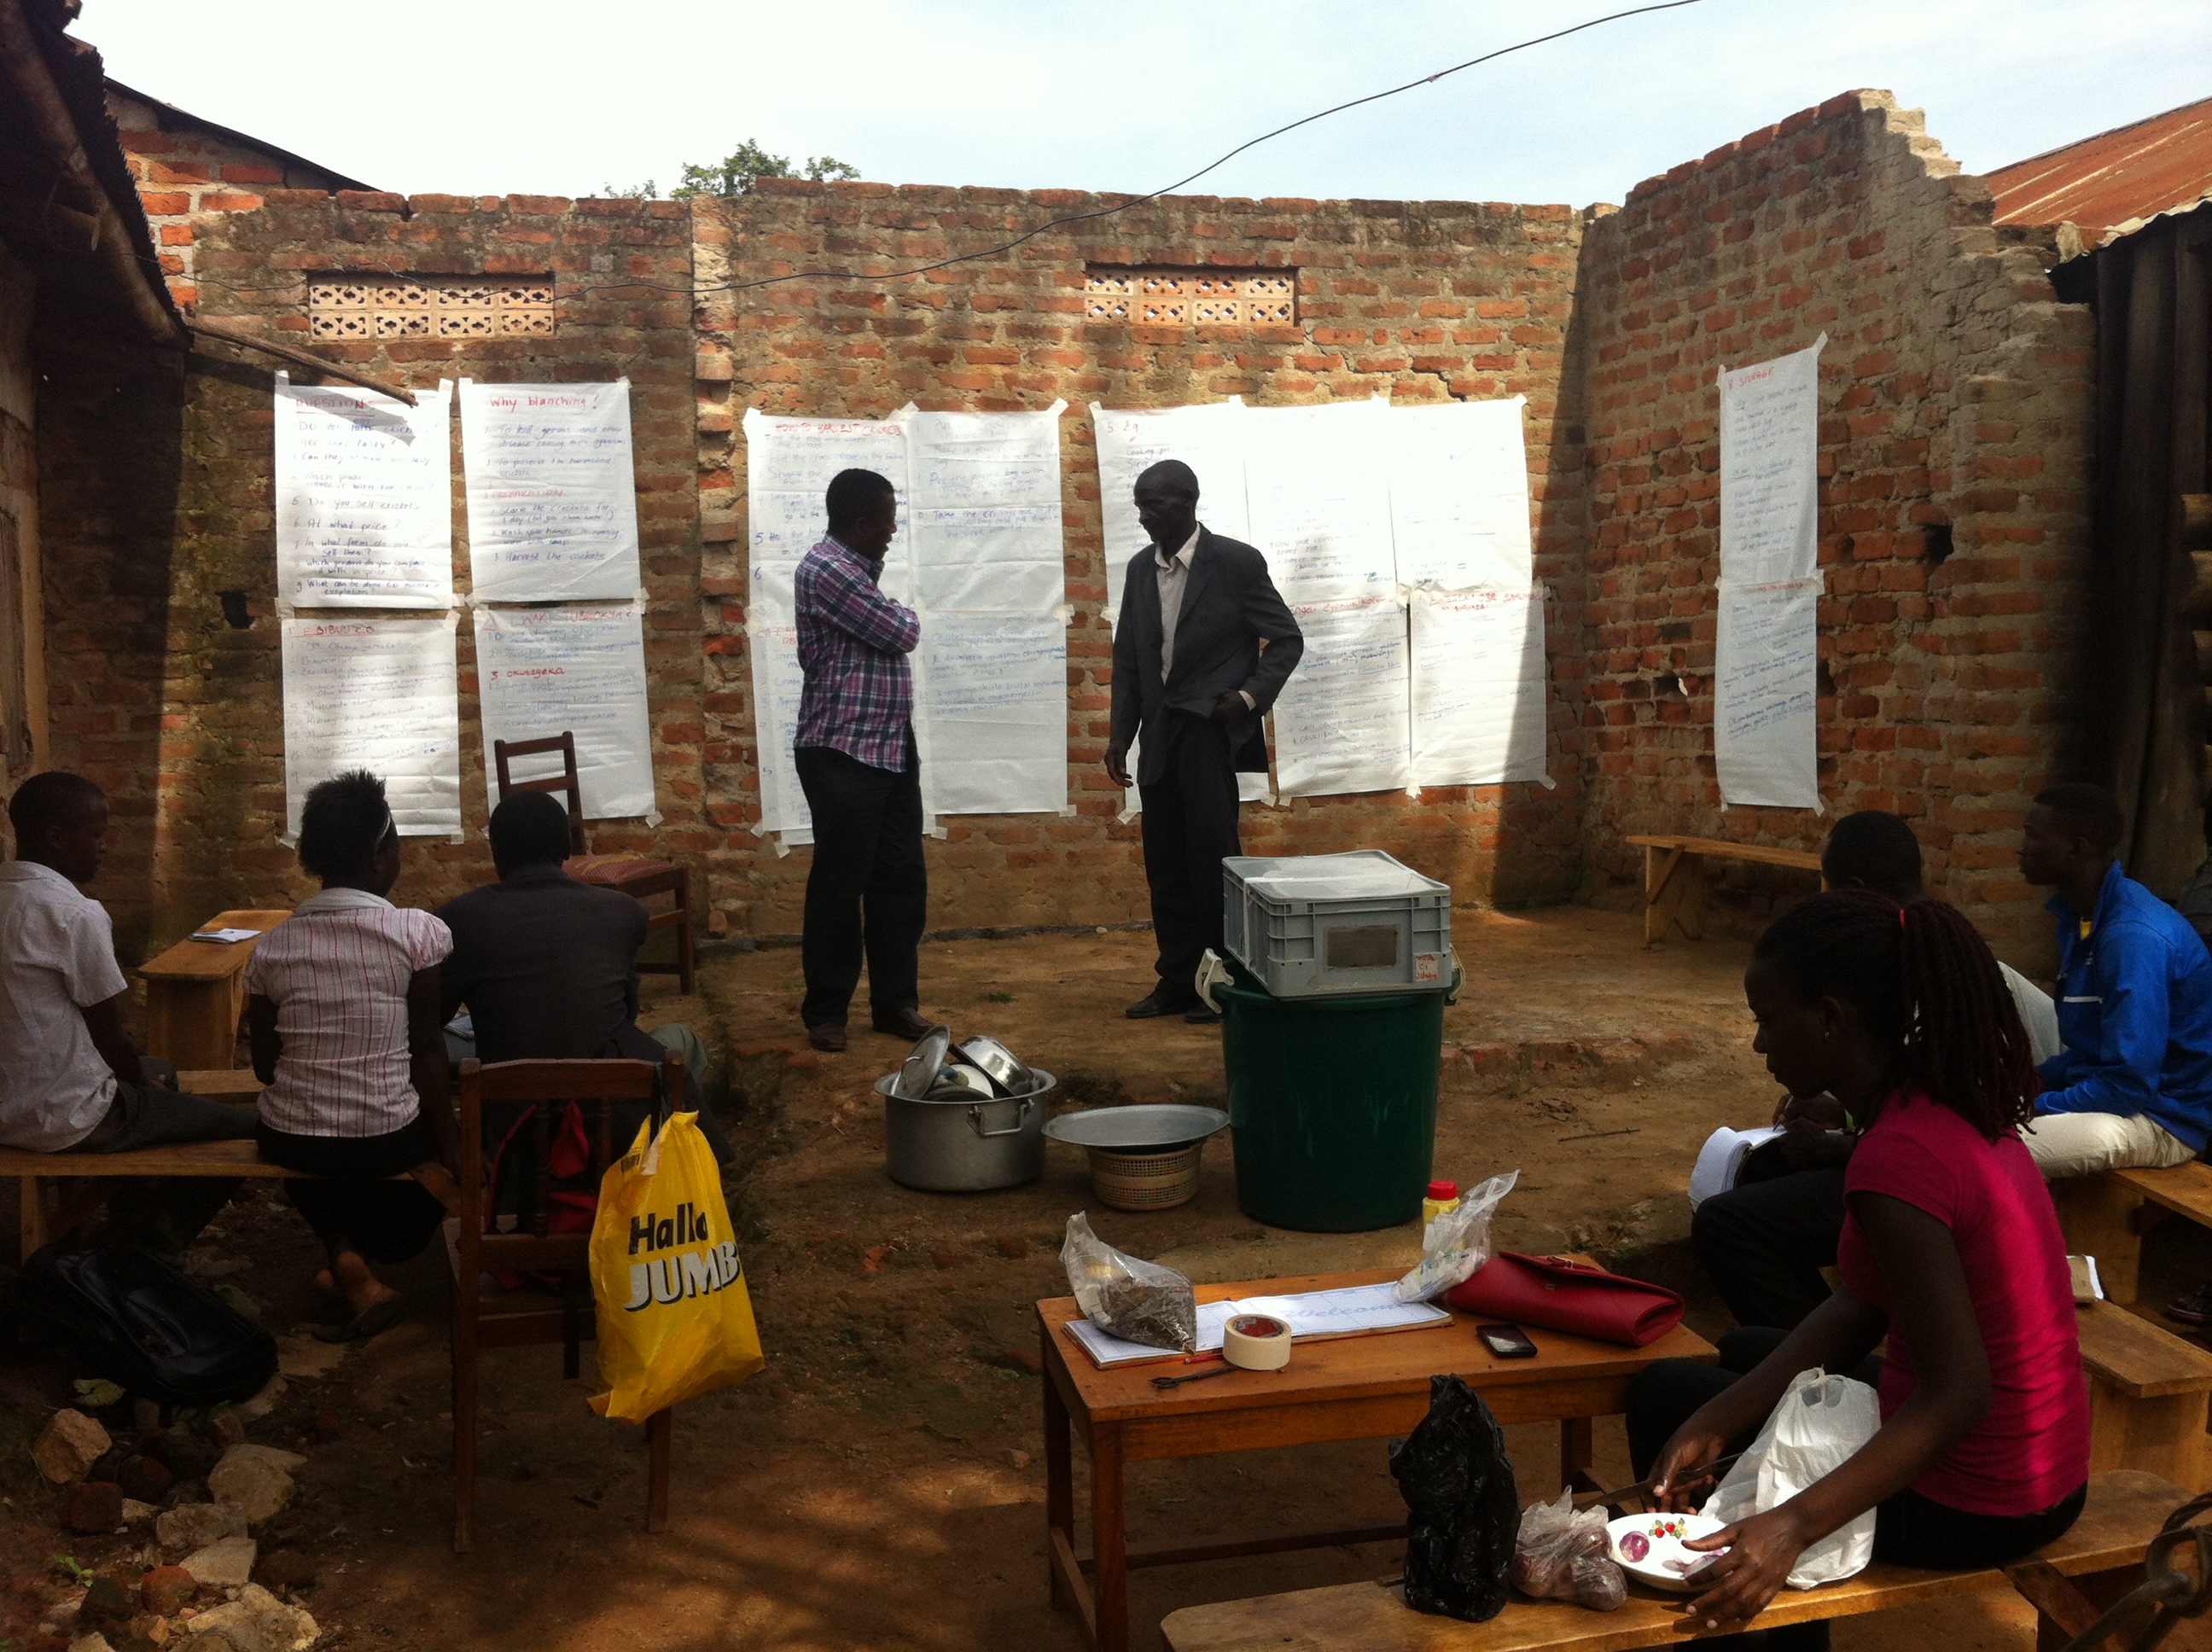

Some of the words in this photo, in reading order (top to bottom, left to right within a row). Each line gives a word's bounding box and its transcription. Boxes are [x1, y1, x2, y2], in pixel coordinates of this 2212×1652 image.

[491, 395, 518, 414] Why
[528, 395, 589, 416] blanching
[628, 1202, 709, 1255] Hallo
